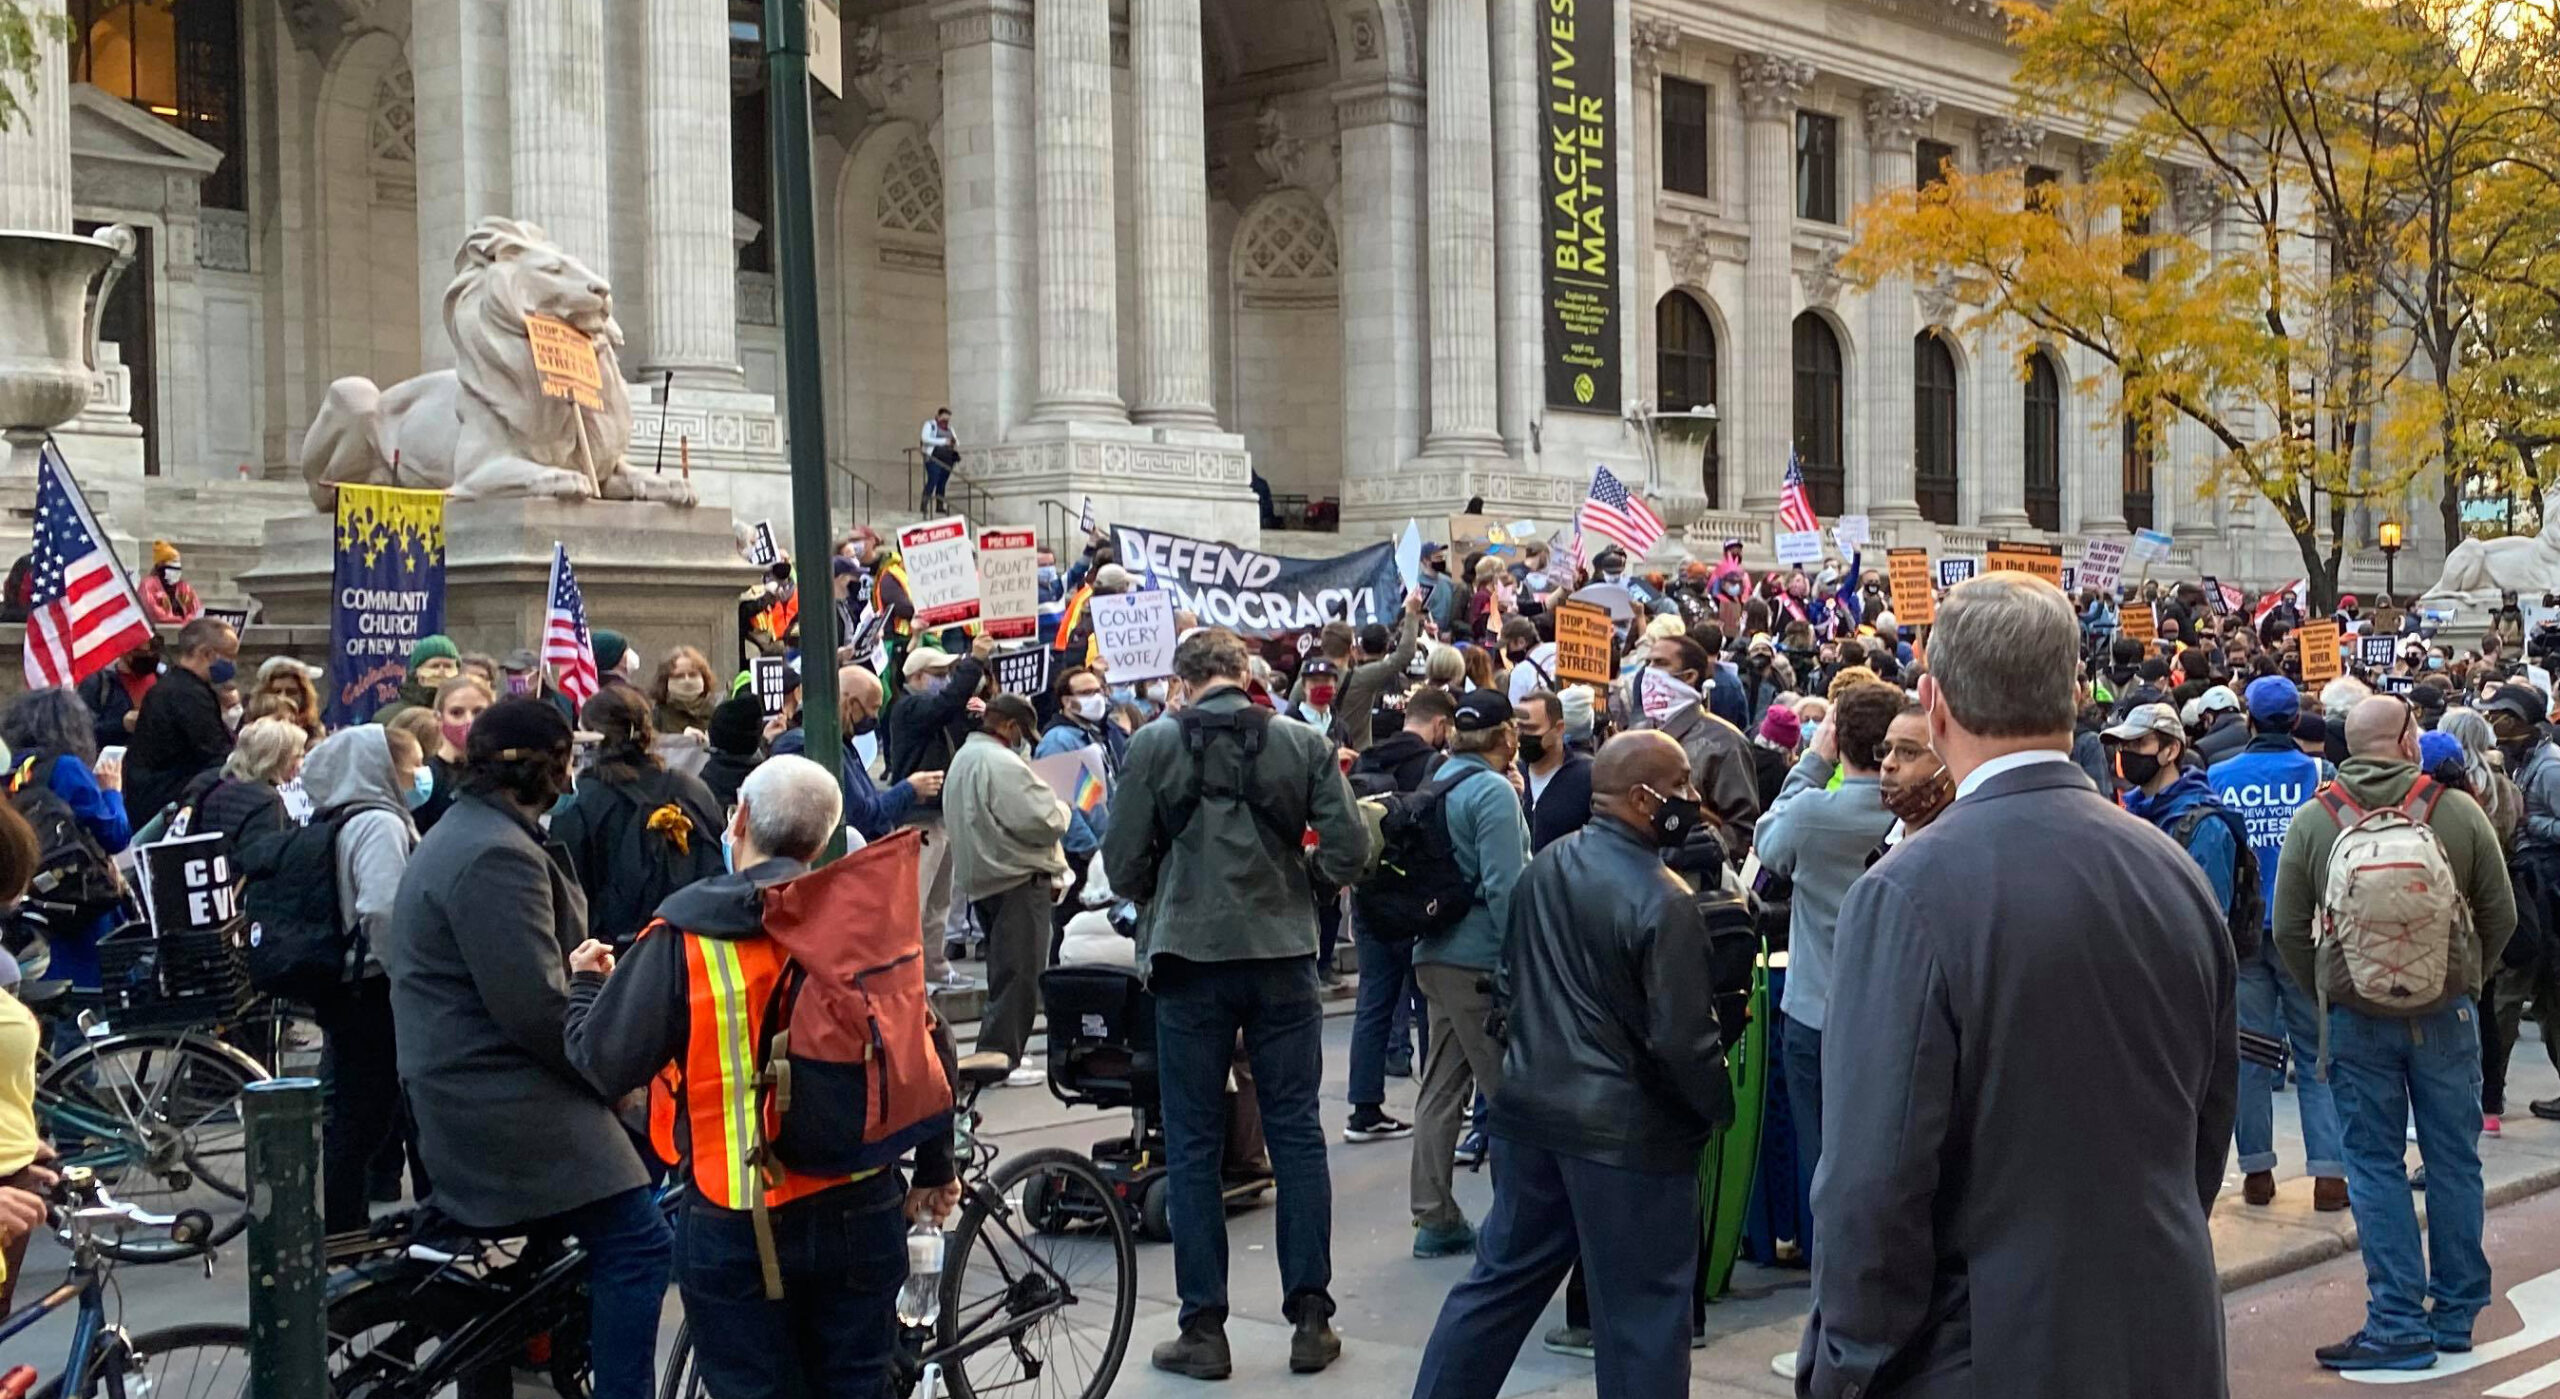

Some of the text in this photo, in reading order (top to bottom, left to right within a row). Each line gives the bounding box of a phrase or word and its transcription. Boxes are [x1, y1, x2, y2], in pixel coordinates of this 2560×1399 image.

[1551, 0, 1580, 271] BLACK LIVES
[1580, 96, 1606, 276] MATTER
[909, 543, 963, 573] COUNT
[983, 556, 1035, 579] COUNT
[1118, 529, 1281, 588] DEFEND
[1991, 557, 2057, 574] In the Name
[920, 563, 963, 586] EVERY
[922, 585, 962, 609] VOTE
[990, 577, 1032, 595] EVERY
[342, 587, 429, 611] COMMUNITY
[990, 598, 1025, 616] VOTE
[359, 613, 418, 634] CHURCH
[1099, 605, 1163, 627] COUNT
[1560, 614, 1582, 628] STOP
[346, 638, 366, 655] OF
[368, 638, 396, 655] NEW
[1106, 625, 1159, 648] EVERY
[1000, 653, 1038, 670] COUNT
[1559, 641, 1607, 660] TAKE TO THE
[1000, 664, 1038, 682] EVERY
[1558, 653, 1607, 676] STREETS!
[2222, 783, 2301, 807] ACLU
[2245, 817, 2290, 833] OTES
[2247, 833, 2286, 848] NITO
[184, 855, 230, 888] CO
